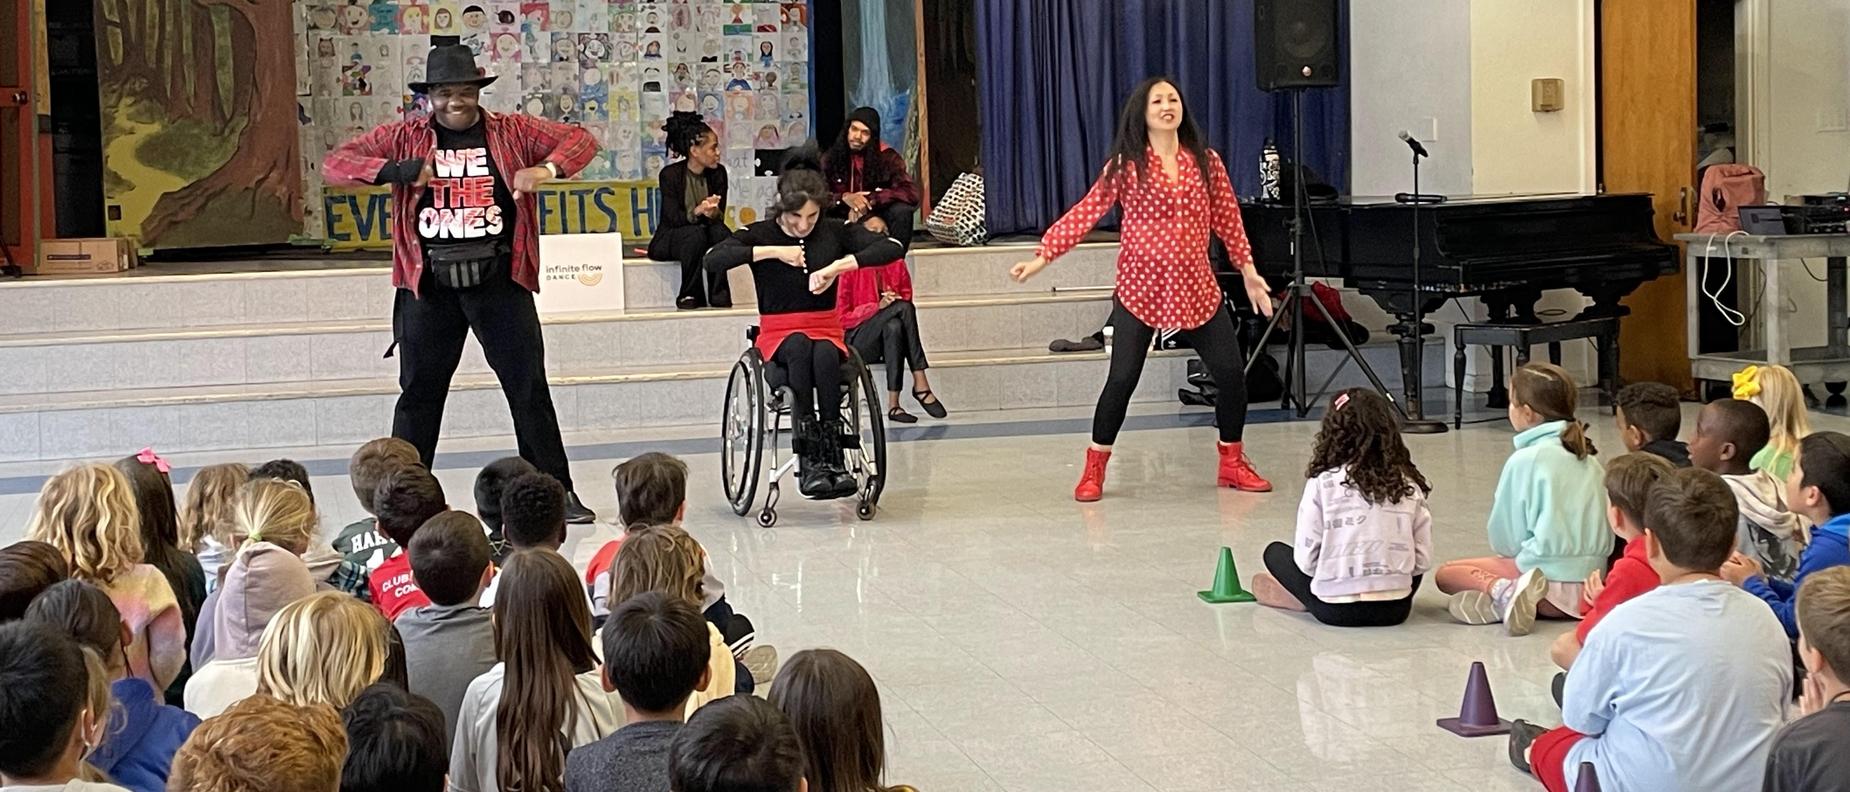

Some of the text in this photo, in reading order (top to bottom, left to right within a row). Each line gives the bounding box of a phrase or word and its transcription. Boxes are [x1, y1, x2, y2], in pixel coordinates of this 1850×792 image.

[435, 148, 489, 177] WE
[428, 176, 494, 208] THE
[419, 205, 503, 238] ONES
[538, 187, 617, 233] FITS
[631, 187, 662, 236] H
[545, 265, 580, 273] infinite
[351, 531, 396, 553] HAR
[382, 569, 414, 592] CLUB
